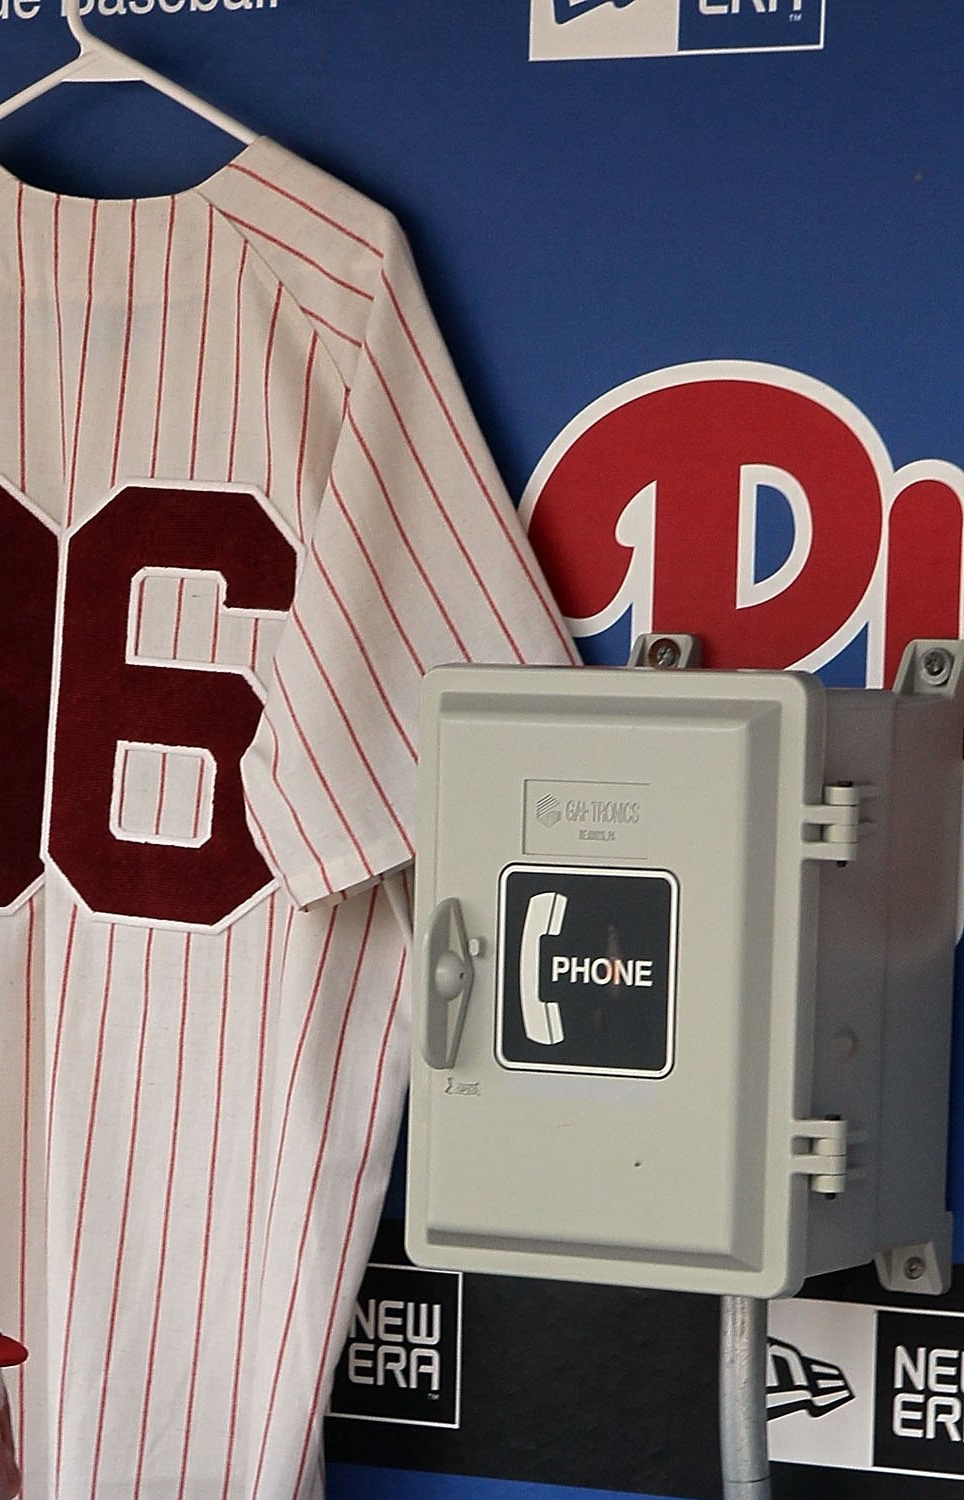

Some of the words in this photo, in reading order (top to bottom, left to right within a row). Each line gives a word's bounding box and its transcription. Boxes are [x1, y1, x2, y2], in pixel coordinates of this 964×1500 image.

[551, 955, 654, 987] PHONE
[349, 1298, 441, 1345] NEW
[347, 1342, 441, 1391] ERA
[893, 1345, 964, 1393] NE
